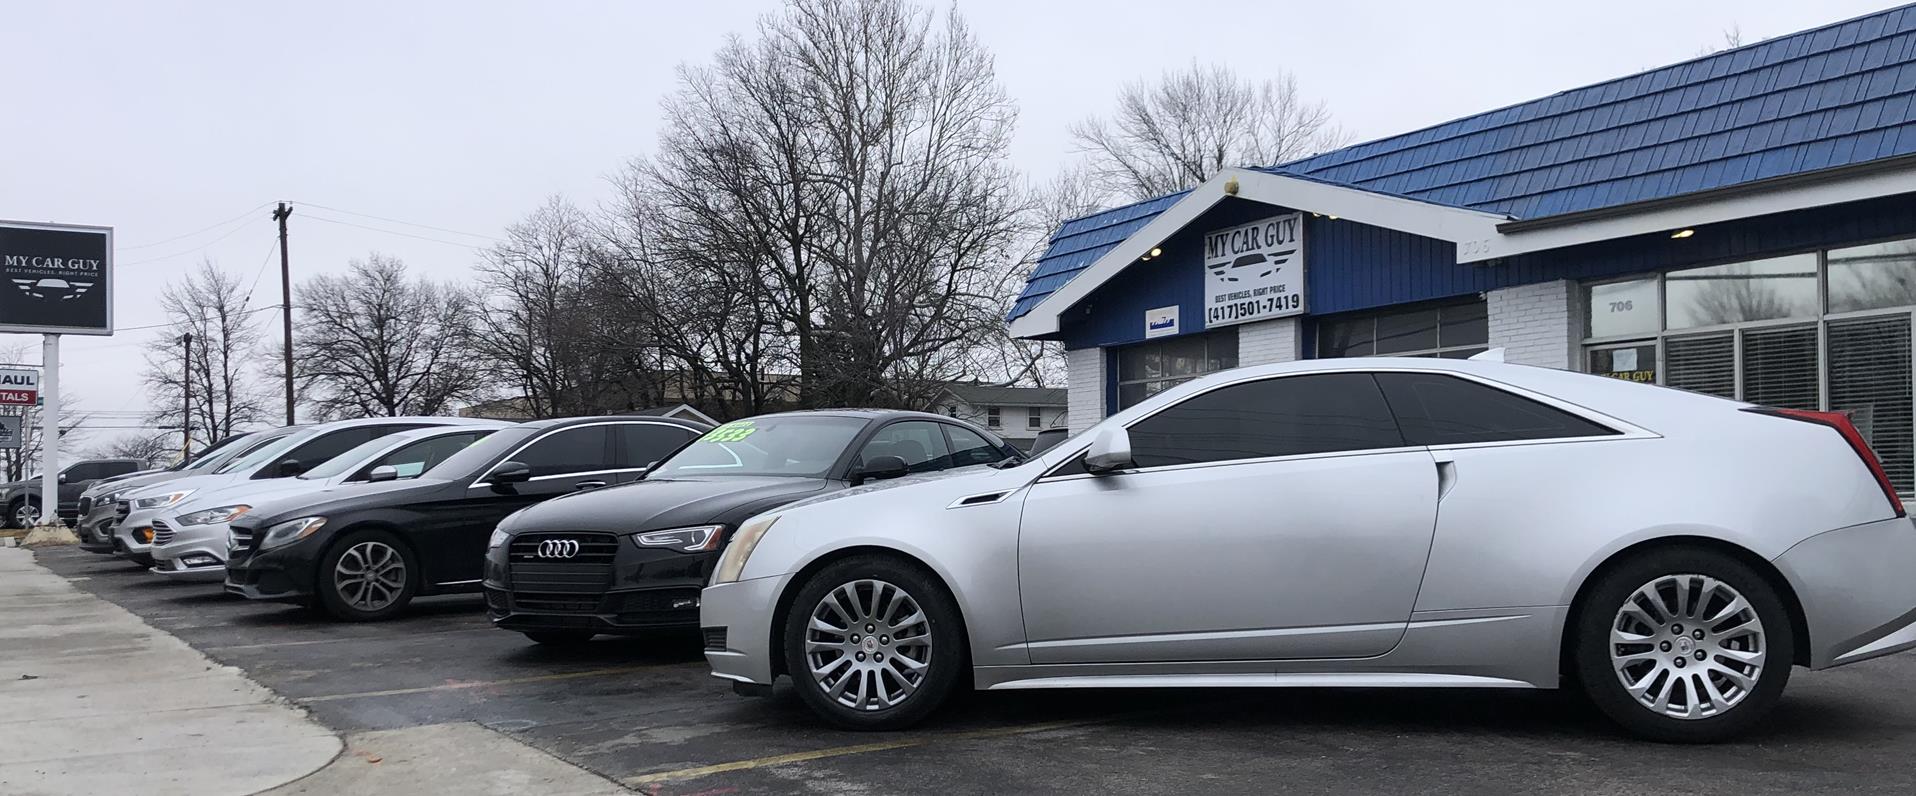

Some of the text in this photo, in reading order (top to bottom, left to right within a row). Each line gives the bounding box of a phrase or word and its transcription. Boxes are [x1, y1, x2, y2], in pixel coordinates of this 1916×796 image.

[1207, 217, 1298, 259] MY CAR GUY
[5, 255, 100, 271] MY CAR GUY
[1215, 293, 1226, 303] BEST
[1253, 287, 1268, 297] RIGHT
[1270, 284, 1286, 294] PRICE
[1609, 300, 1633, 313] 706
[0, 375, 35, 385] AUL
[1633, 370, 1654, 382] GUY
